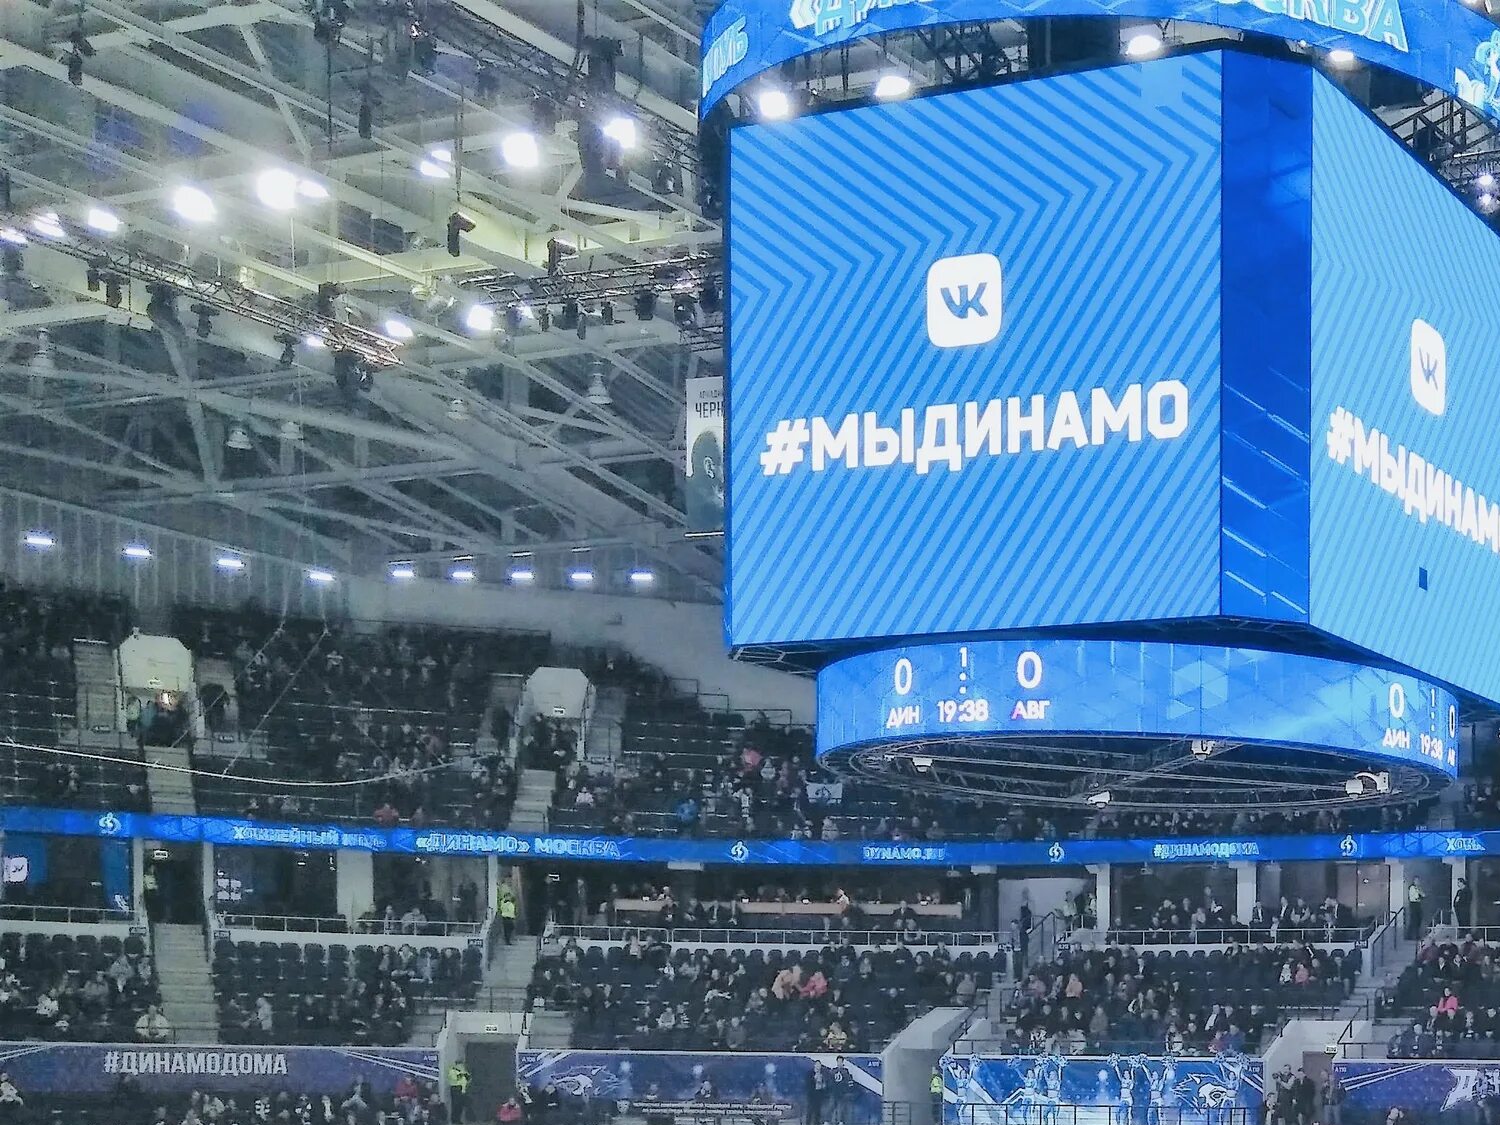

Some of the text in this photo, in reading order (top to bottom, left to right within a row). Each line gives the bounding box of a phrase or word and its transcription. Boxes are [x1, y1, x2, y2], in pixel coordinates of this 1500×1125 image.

[760, 379, 1188, 476] #МЫДИНАМО
[894, 658, 912, 695] 0
[1017, 651, 1042, 689] 0
[886, 699, 1050, 729] ДИН 19:38 АВГ
[1389, 682, 1405, 718] 0
[103, 1051, 288, 1077] #ДИНАМОДОМА
